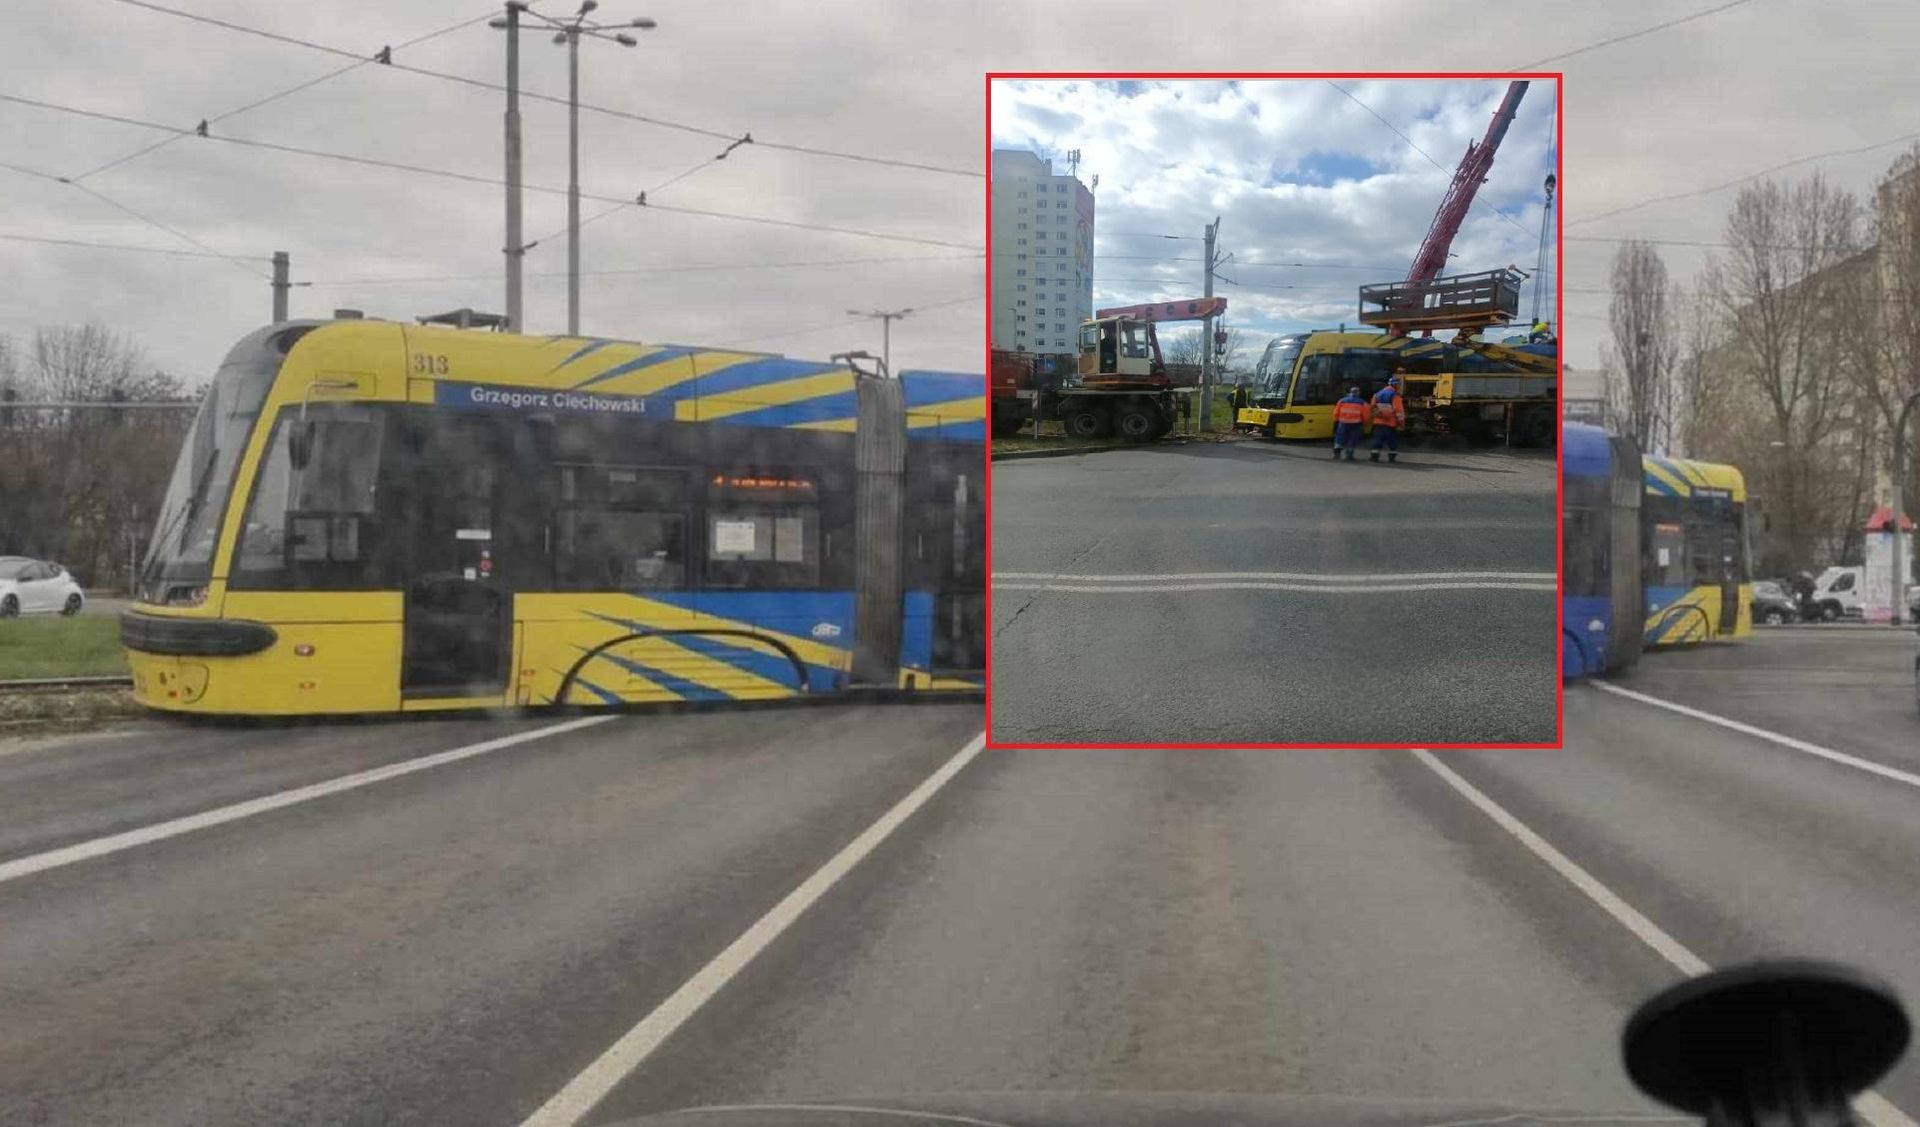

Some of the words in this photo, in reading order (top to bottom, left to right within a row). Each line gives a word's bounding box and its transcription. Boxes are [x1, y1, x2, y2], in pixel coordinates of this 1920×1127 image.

[414, 354, 448, 374] 313
[470, 386, 548, 407] Grzegorz
[553, 392, 646, 413] Ciechowski
